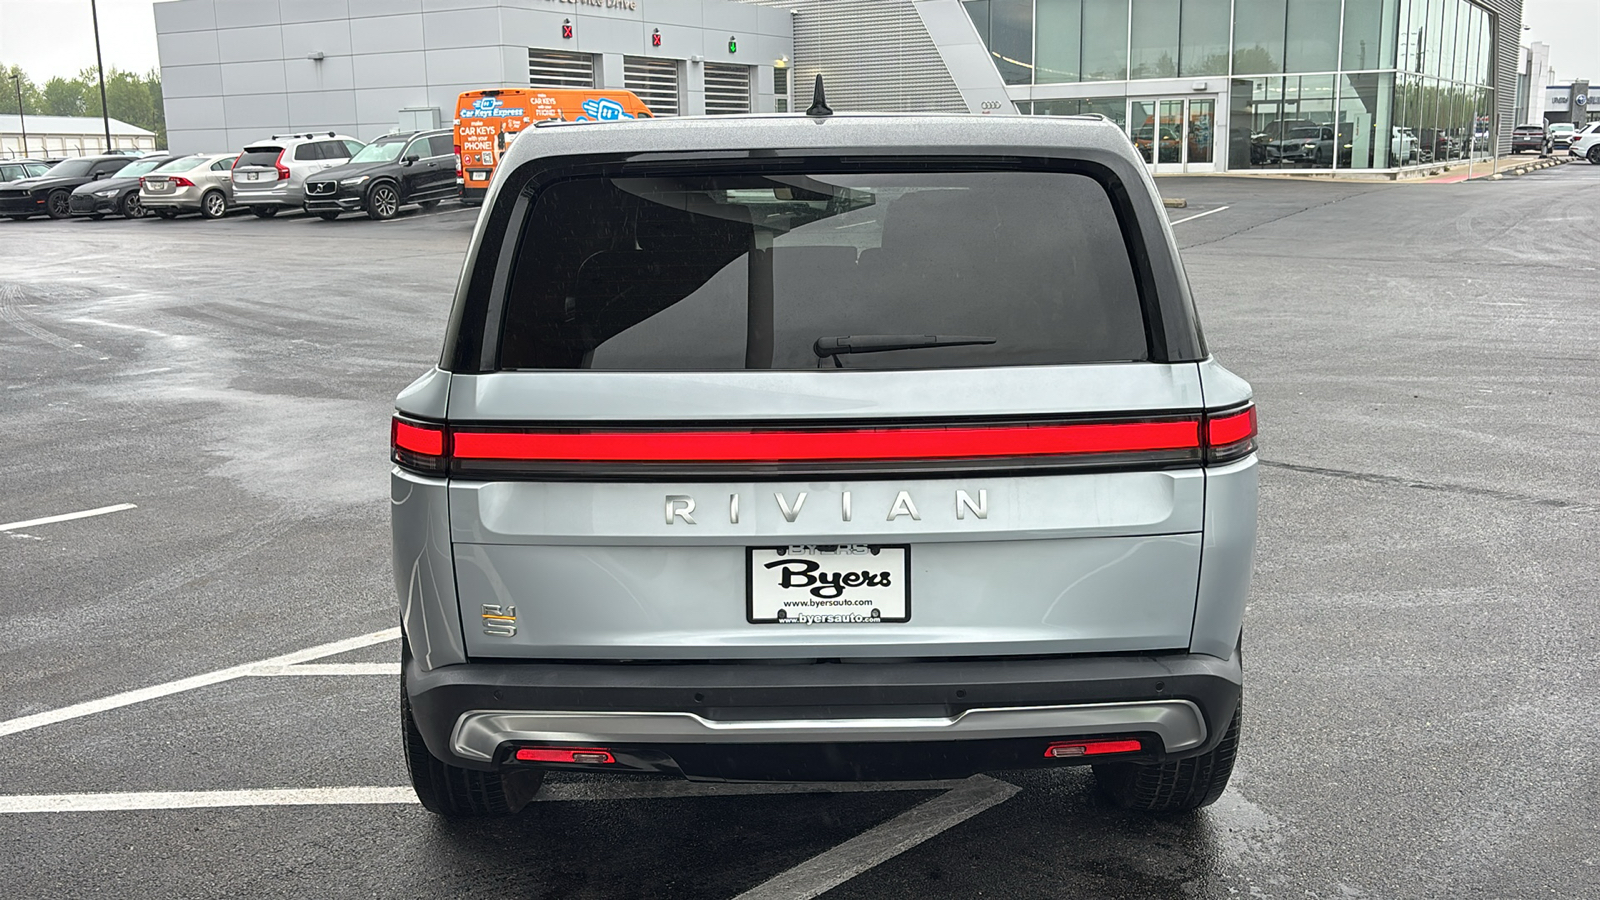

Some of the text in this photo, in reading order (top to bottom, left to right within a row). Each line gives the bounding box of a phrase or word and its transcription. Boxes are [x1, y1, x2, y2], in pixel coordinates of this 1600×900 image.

[606, 0, 636, 11] Drive
[460, 108, 524, 118] Car Keys Express
[460, 126, 495, 135] CAR KEYS
[464, 142, 492, 150] PHONE!
[665, 489, 988, 524] RIVIAN
[764, 558, 891, 599] Byers
[783, 599, 873, 608] www.byersauto.com
[779, 612, 881, 626] www.byersauto.com
